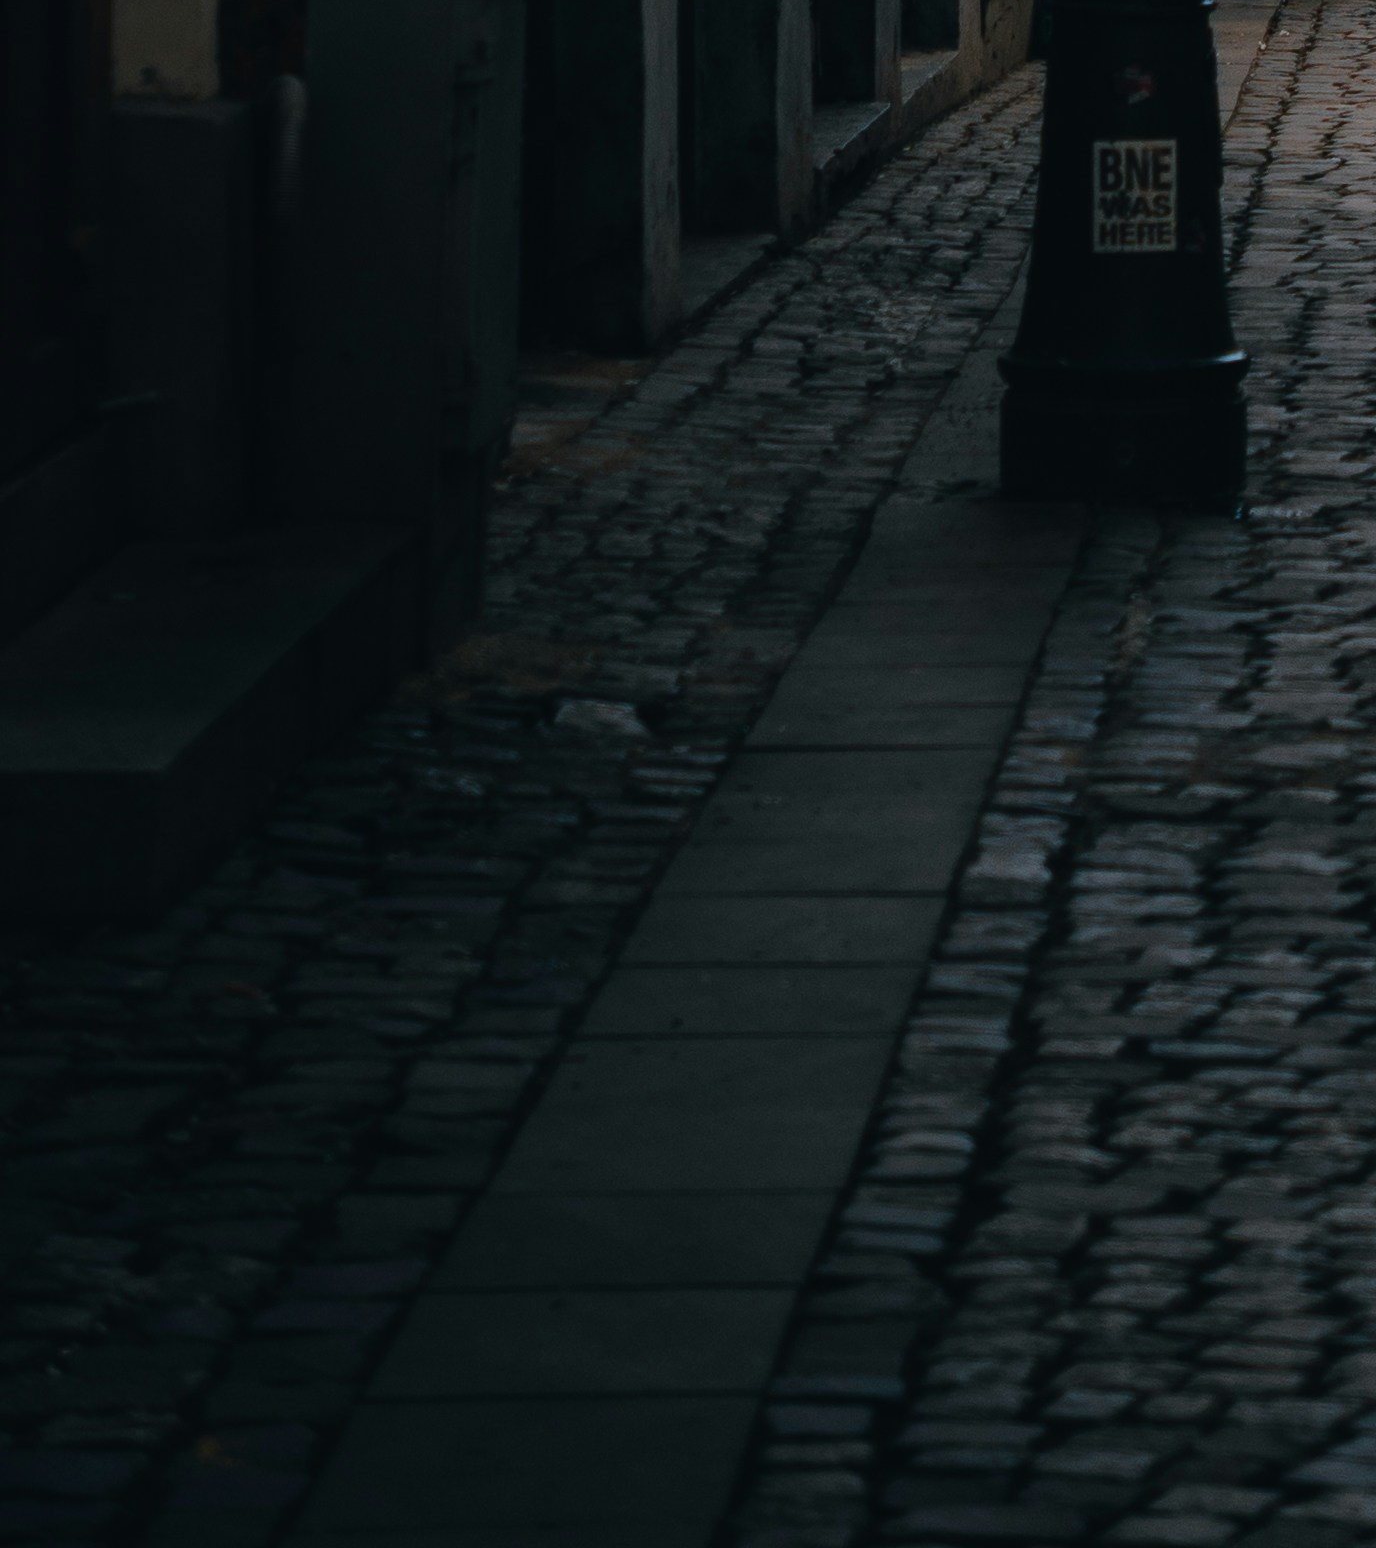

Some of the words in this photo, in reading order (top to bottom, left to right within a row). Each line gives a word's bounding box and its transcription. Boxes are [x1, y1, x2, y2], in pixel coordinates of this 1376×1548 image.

[1099, 147, 1172, 192] BNE
[1099, 193, 1172, 220] WAS
[1099, 221, 1173, 246] HERE
